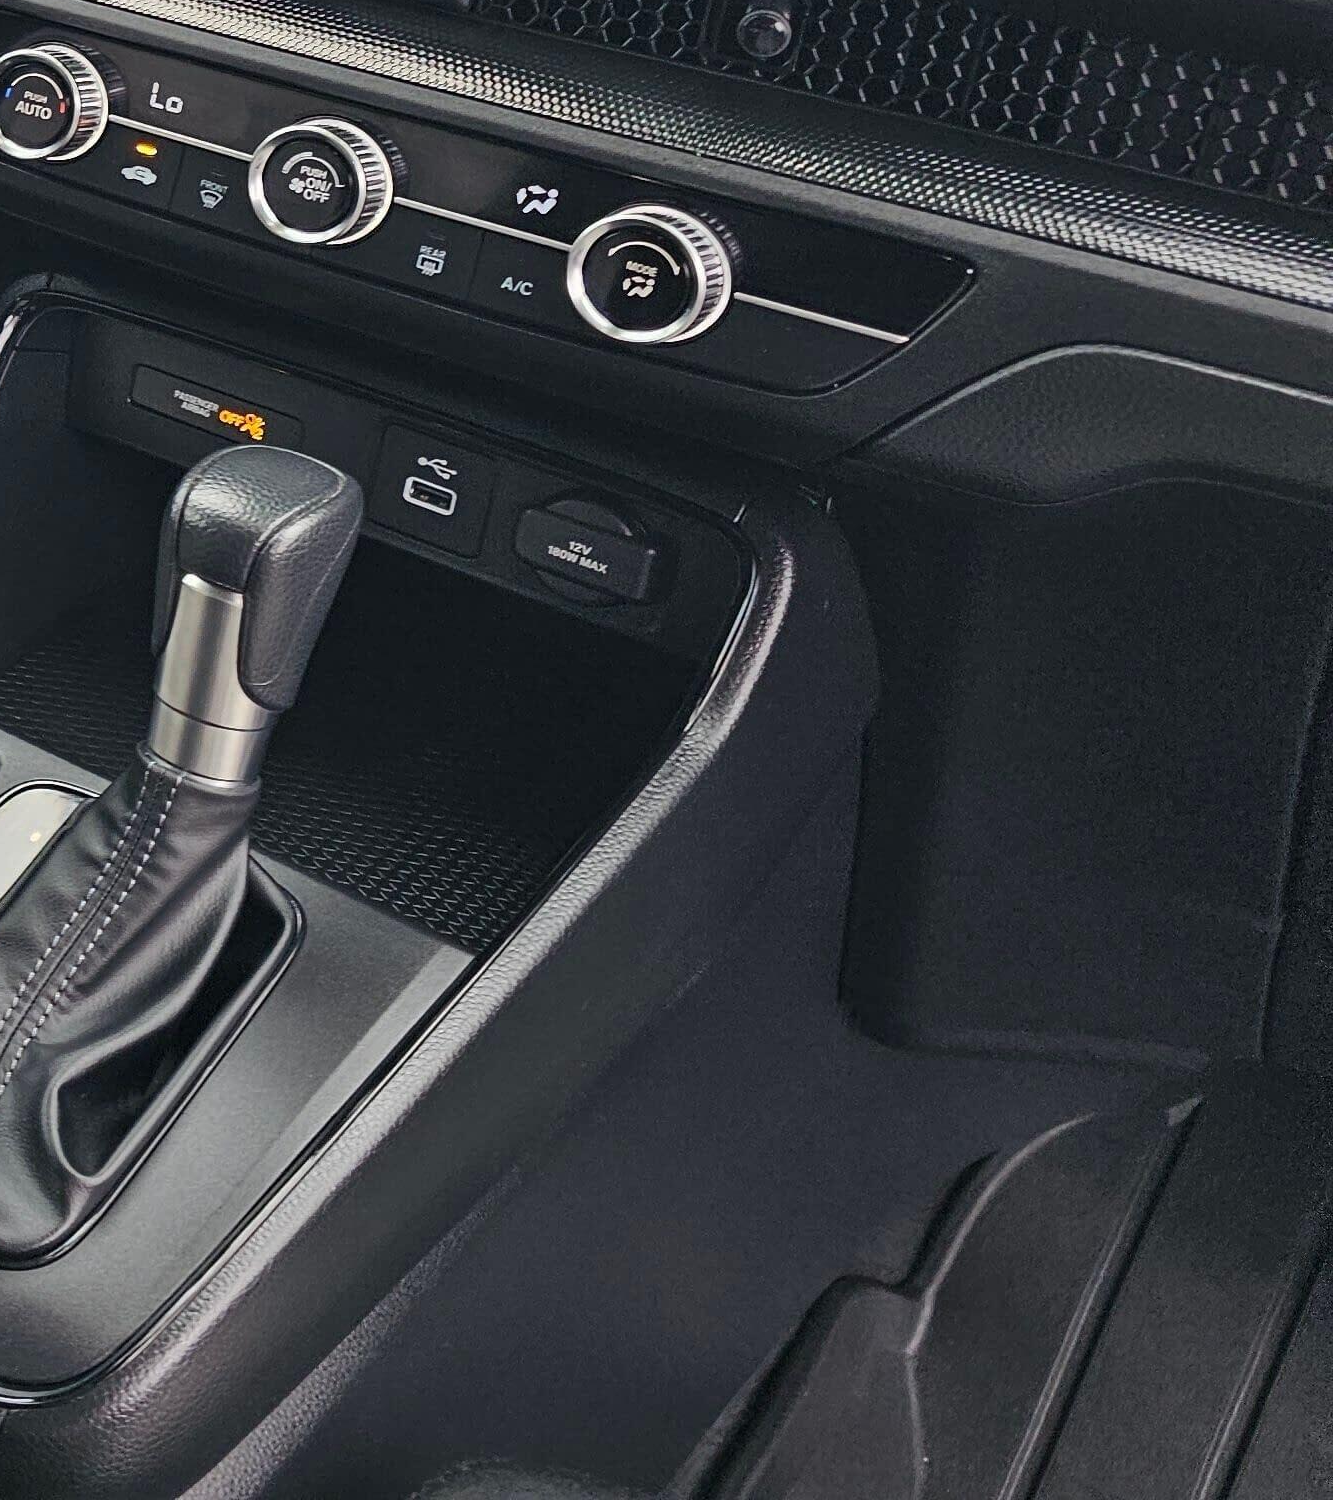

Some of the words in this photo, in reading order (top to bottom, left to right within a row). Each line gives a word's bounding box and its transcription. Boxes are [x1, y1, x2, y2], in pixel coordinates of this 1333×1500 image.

[23, 90, 48, 104] PUSH
[14, 100, 53, 121] AUTO
[299, 165, 328, 180] PUSH
[199, 179, 229, 195] FRONT
[302, 188, 331, 203] OFF
[419, 245, 447, 259] REAR
[625, 260, 659, 277] MODE
[500, 276, 534, 296] A/C
[219, 409, 245, 427] OFF
[568, 541, 593, 556] 12V
[579, 556, 609, 575] MAX
